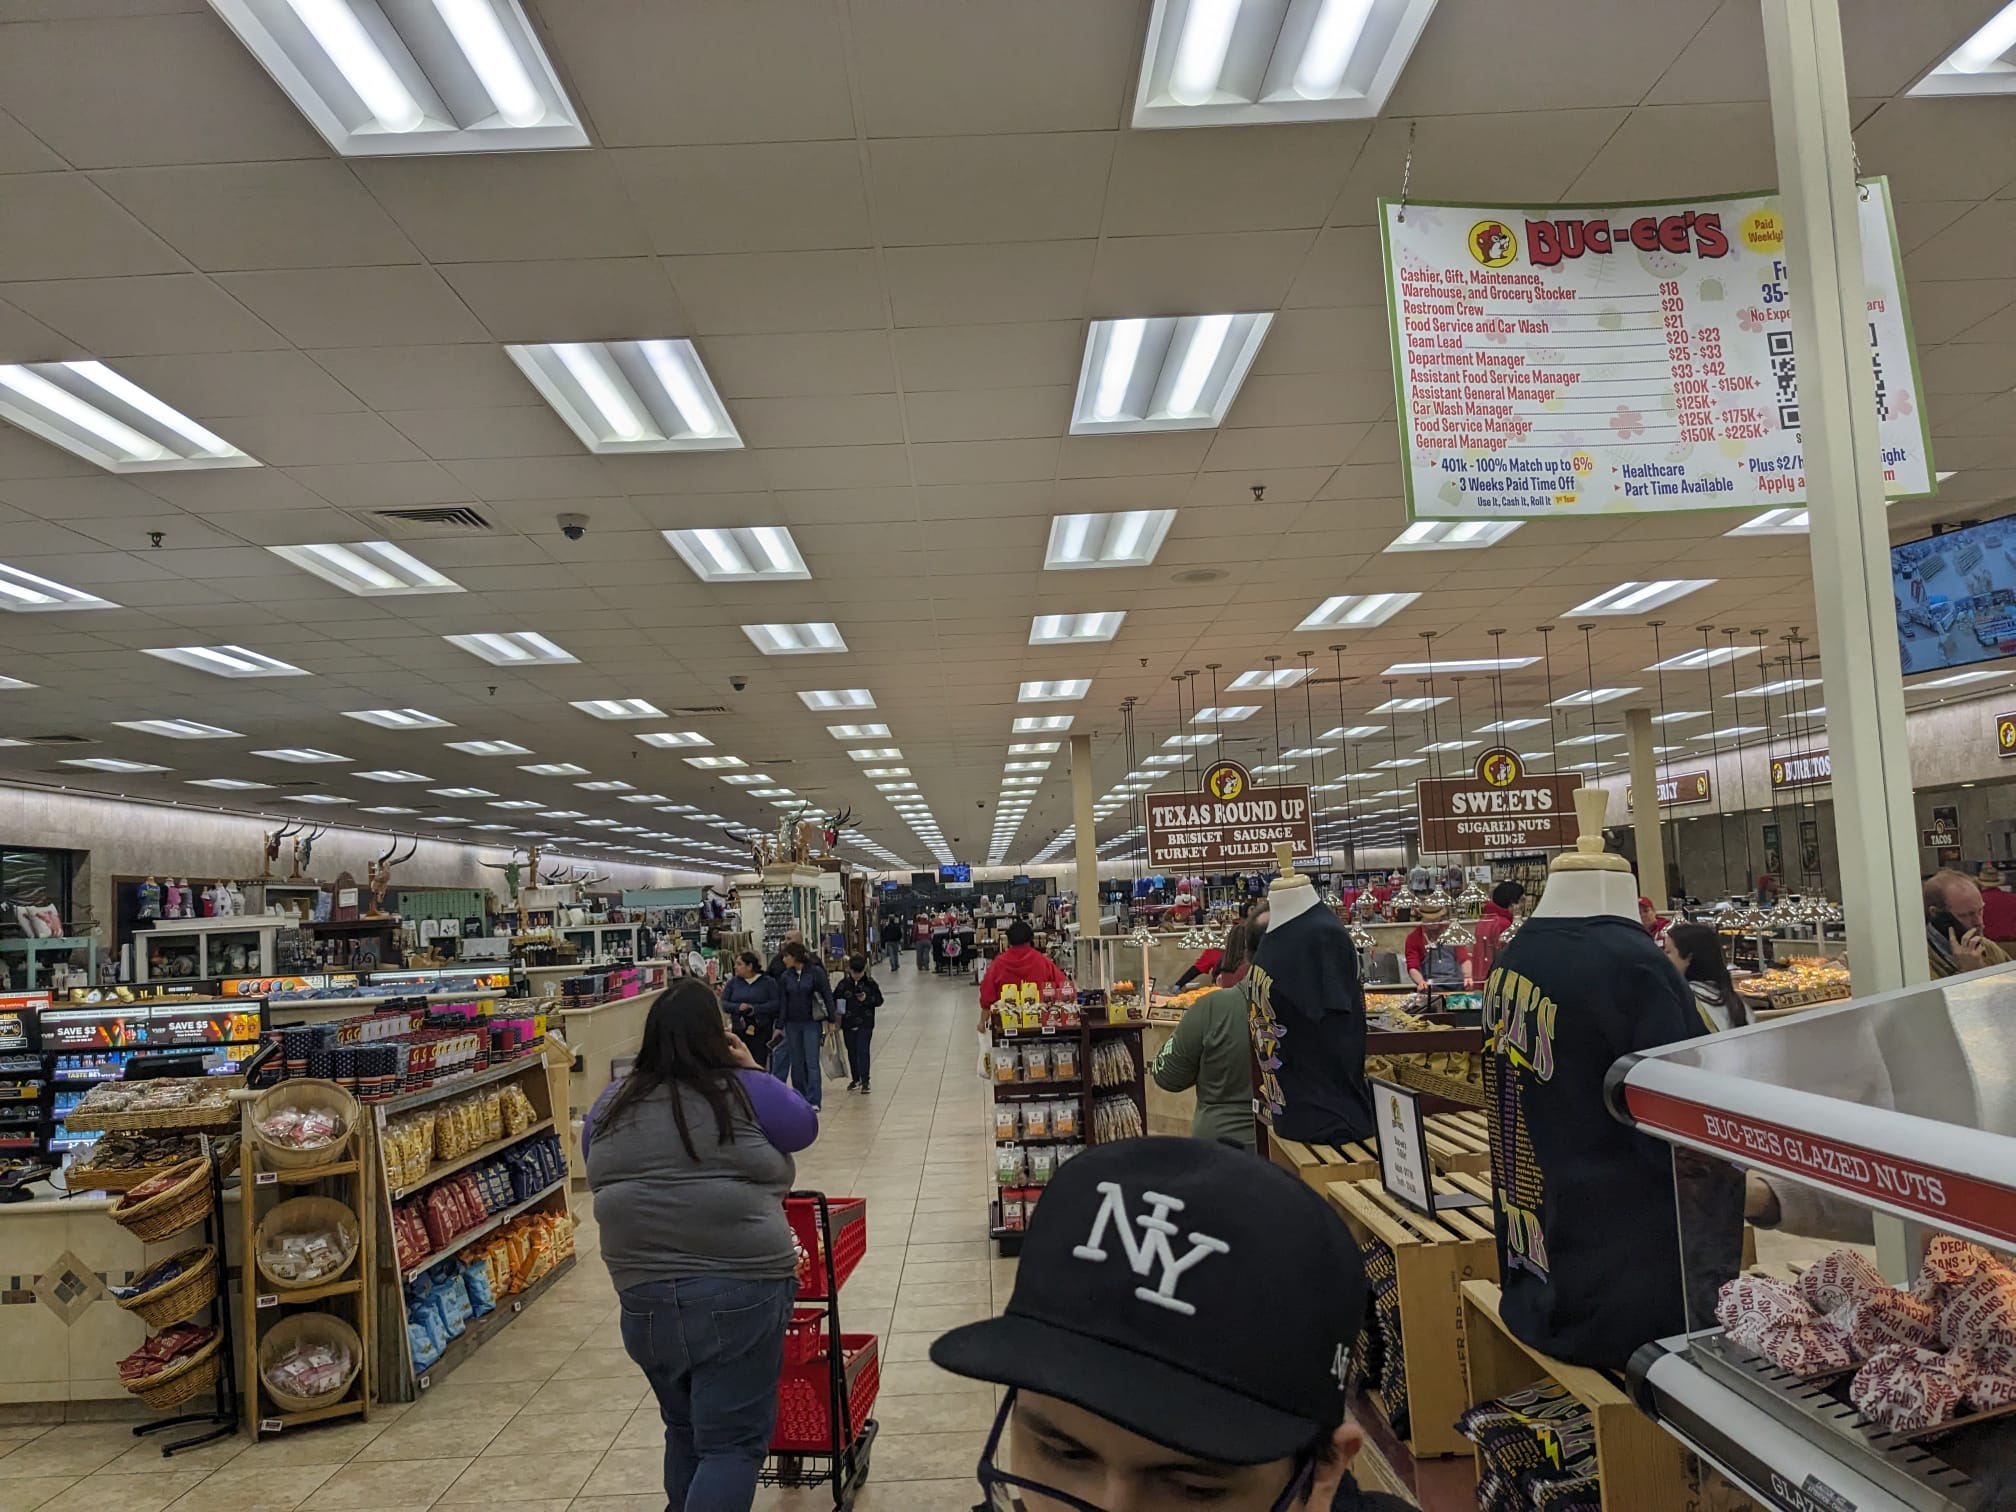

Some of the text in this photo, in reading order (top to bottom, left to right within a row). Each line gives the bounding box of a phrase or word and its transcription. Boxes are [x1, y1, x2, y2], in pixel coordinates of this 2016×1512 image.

[1754, 219, 1774, 230] Paid
[1525, 210, 1729, 267] BUC-EE'S
[1400, 268, 1544, 286] Cashier, Gift, Maintenance,
[1401, 281, 1680, 303] Warehouse, and Grocery Stocker $18
[1403, 298, 1684, 316] Restroom Crew $20
[1750, 309, 1765, 323] No
[1866, 300, 1885, 312] ary
[1405, 314, 1684, 334] Food Service and Car Wash $21
[1407, 334, 1435, 348] Team
[1437, 334, 1463, 348] Lead
[1666, 330, 1689, 345] $20
[1698, 327, 1720, 343] $23
[1408, 350, 1473, 368] Department
[1475, 352, 1526, 369] Manager
[1669, 346, 1690, 362] $25
[1700, 344, 1722, 360] $33
[1410, 369, 1460, 383] Assistant
[1462, 370, 1488, 384] Food
[1489, 370, 1531, 384] Service
[1532, 370, 1581, 387] Manager
[1671, 363, 1694, 378] $33
[1702, 361, 1726, 377] $42
[1412, 385, 1462, 399] Assistant
[1464, 386, 1505, 400] General
[1507, 387, 1556, 403] Manager
[1673, 379, 1709, 395] $100K
[1718, 376, 1761, 392] $150K+
[1413, 396, 1717, 419] Car Wash Manager $125K+
[1414, 418, 1440, 432] Food
[1442, 418, 1482, 432] Service
[1484, 418, 1533, 435] Manager
[1678, 411, 1713, 427] $125K
[1721, 408, 1764, 425] $175K+
[1416, 434, 1457, 449] General
[1459, 435, 1508, 452] Manager
[1680, 427, 1716, 443] $150K
[1724, 424, 1770, 440] $225K+
[1441, 459, 1467, 473] 401k
[1476, 458, 1507, 473] 100%
[1509, 458, 1543, 472] Match
[1544, 461, 1558, 475] up
[1559, 458, 1571, 471] to
[1573, 457, 1593, 471] 6%
[1749, 458, 1774, 472] Plus
[1881, 448, 1906, 466] ight
[1622, 464, 1685, 479] Healthcare
[1459, 476, 1575, 491] 3 Weeks Paid Time Off
[1625, 478, 1734, 497] Part Time Available
[1759, 475, 1795, 494] Apply
[1502, 496, 1520, 507] Cash
[1657, 781, 1678, 800] ERKY
[1452, 788, 1553, 814] SWEETS
[1152, 798, 1305, 827] TEXAS ROUND UP
[1168, 827, 1293, 845] BRISKET SAUSAGE
[1457, 819, 1551, 834] SUGARED NUTS
[1484, 833, 1526, 846] FUDGE
[1931, 834, 1952, 845] TACOS
[1155, 846, 1208, 860] TURKEY
[1219, 842, 1269, 856] PULLED
[57, 1027, 82, 1036] SAVE
[169, 1020, 208, 1031] SAVE $5
[1703, 1114, 1947, 1206] BUC-EE'S GLAZED NUTS
[1073, 1181, 1230, 1316] NY
[1965, 1296, 2004, 1332] PECANS
